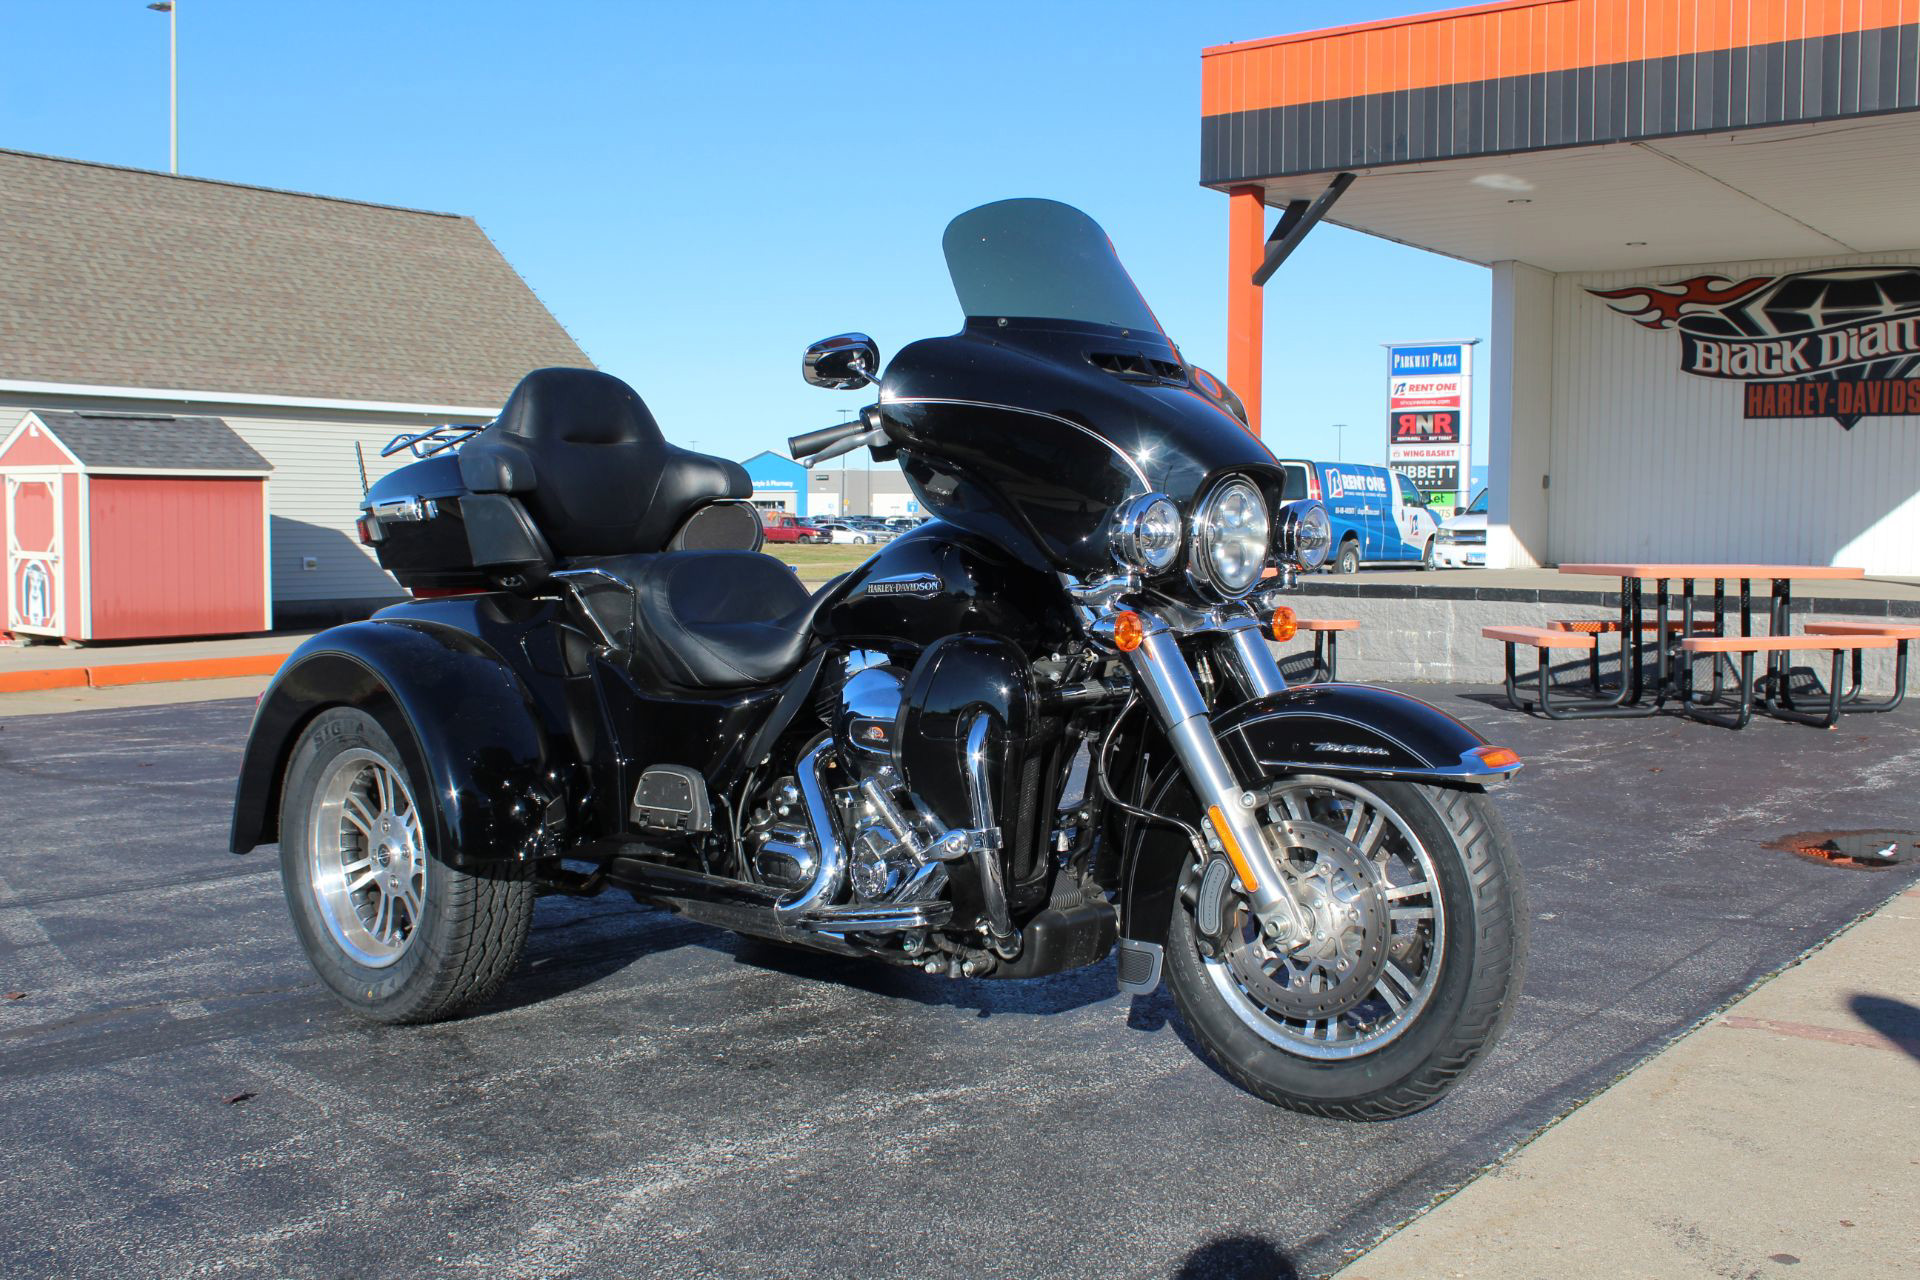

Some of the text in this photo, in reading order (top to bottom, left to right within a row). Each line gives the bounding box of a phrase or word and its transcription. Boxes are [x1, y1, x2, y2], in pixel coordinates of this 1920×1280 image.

[1433, 352, 1457, 367] PLAZA
[1409, 383, 1457, 392] RENT ONE
[1341, 474, 1386, 492] RENT ONE
[867, 581, 938, 593] HARLEY-DAVIDSON
